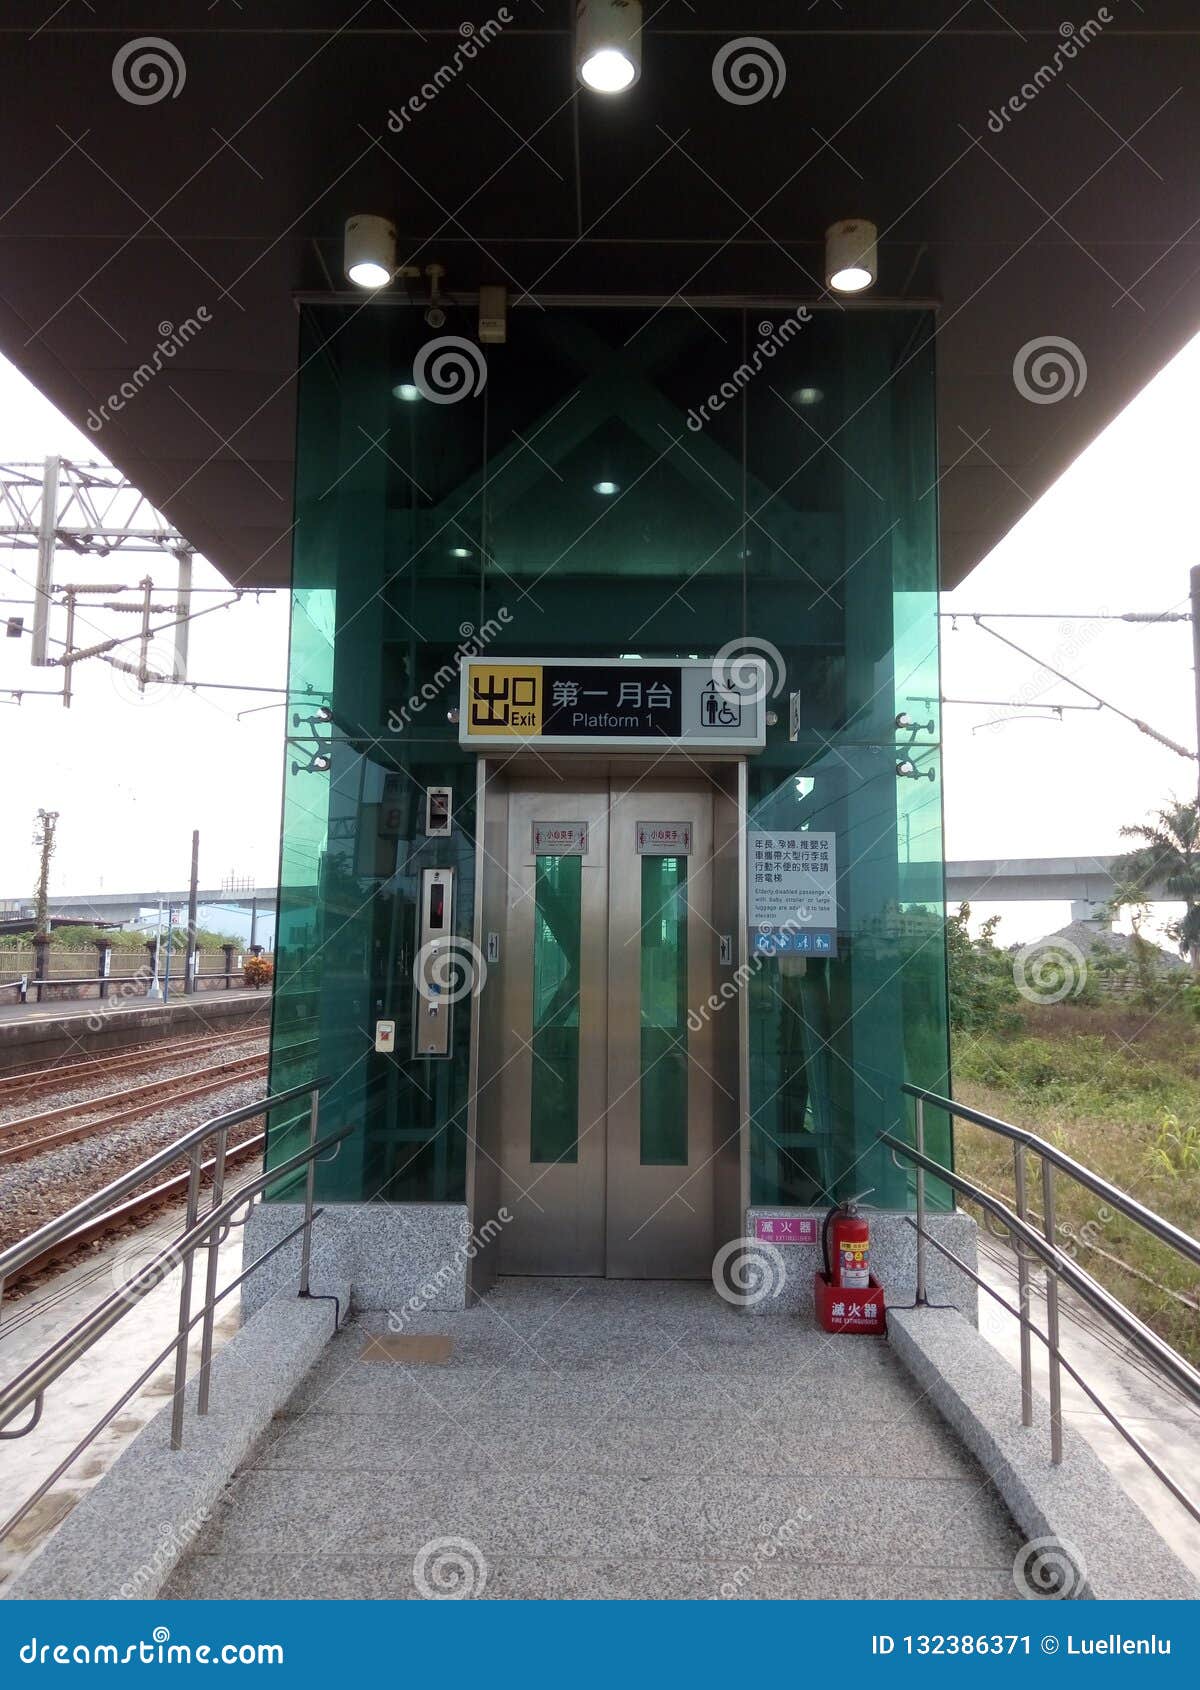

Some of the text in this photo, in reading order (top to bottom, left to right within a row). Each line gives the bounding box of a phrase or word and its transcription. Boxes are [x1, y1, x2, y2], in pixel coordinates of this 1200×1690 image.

[472, 675, 536, 726] 出口
[552, 680, 673, 709] 第一月台
[511, 711, 536, 727] Exit
[572, 712, 653, 728] Platform 1
[761, 1221, 812, 1233] 滅火器
[831, 1302, 878, 1318] 滅火器
